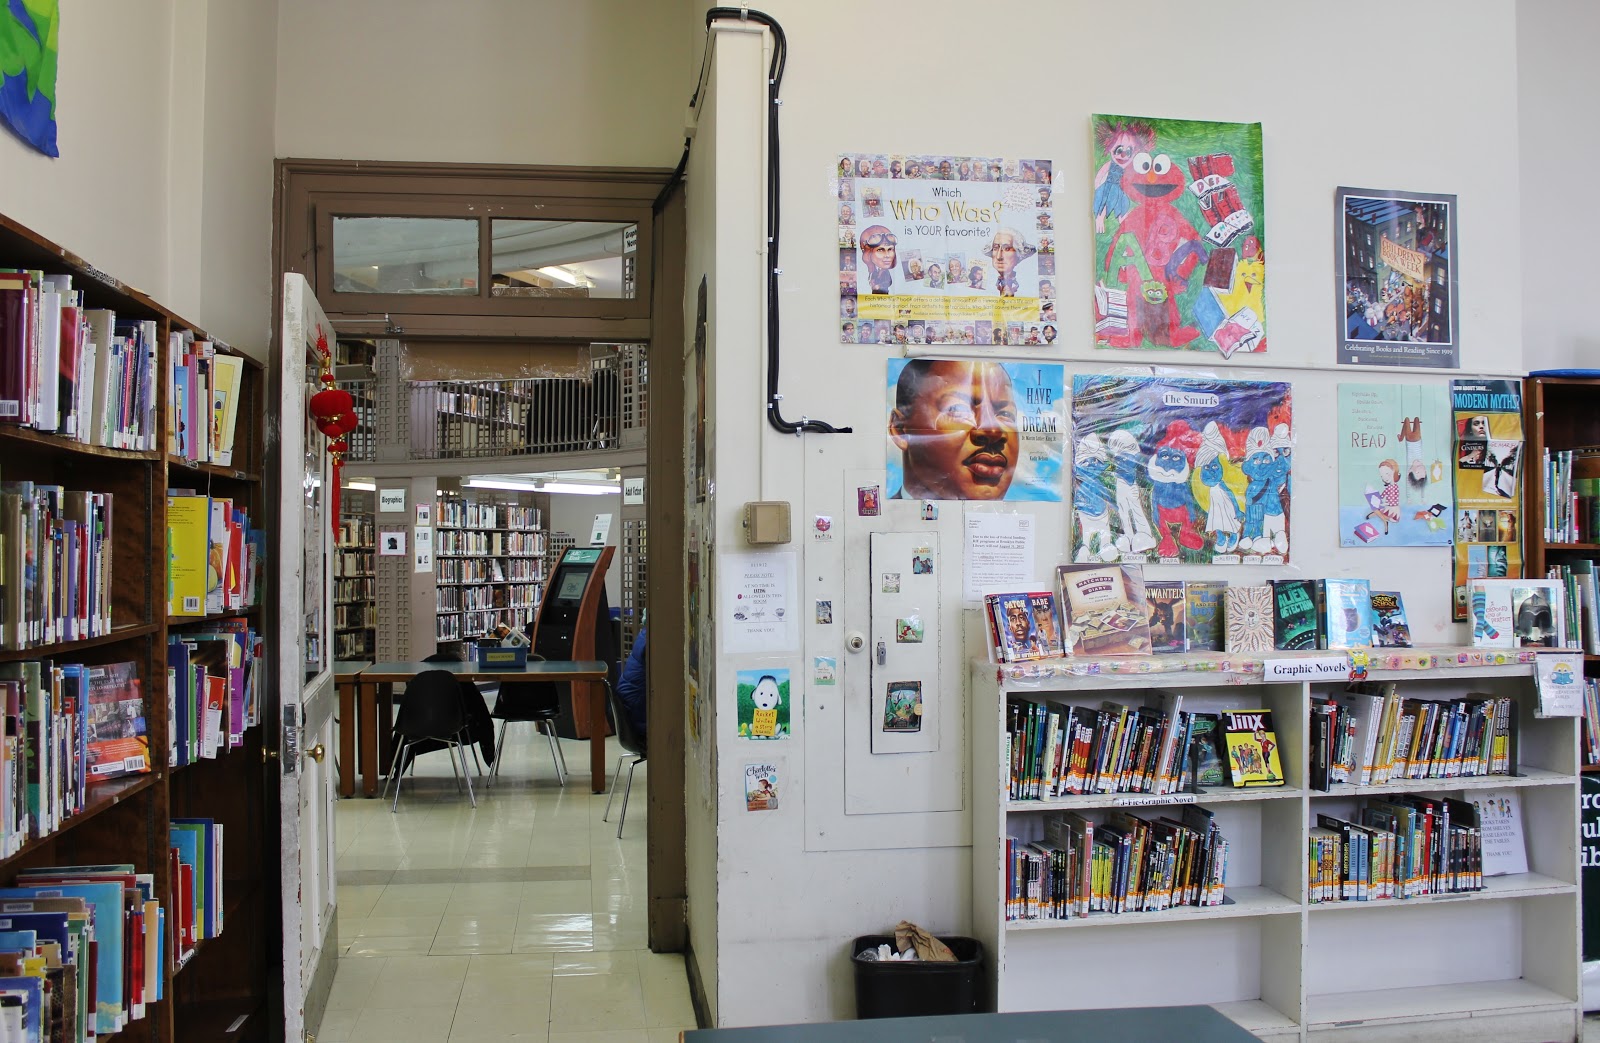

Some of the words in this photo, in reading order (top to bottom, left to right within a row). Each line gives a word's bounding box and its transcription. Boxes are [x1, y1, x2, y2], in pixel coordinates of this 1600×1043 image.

[932, 187, 962, 198] Which
[889, 198, 940, 221] Who
[946, 200, 1003, 223] Was?
[625, 230, 637, 239] Grap
[904, 226, 912, 235] is
[915, 225, 942, 236] YOUR
[945, 225, 991, 237] favorite?
[1344, 343, 1375, 354] Celebrating
[1376, 345, 1392, 353] Books
[1392, 345, 1403, 353] and
[1403, 346, 1426, 355] Reading
[1426, 347, 1440, 355] Since
[1441, 348, 1453, 356] 1919
[1037, 369, 1042, 386] I
[1026, 387, 1052, 404] HAVE
[1164, 394, 1182, 404] The
[1183, 394, 1218, 406] Smurfs
[1454, 393, 1488, 409] MODERN
[1490, 393, 1520, 410] MYTHS?
[1022, 416, 1057, 433] DREAM
[1351, 431, 1387, 449] READ
[1078, 577, 1112, 587] MATCHBOX
[1145, 587, 1184, 599] NWANTEDS
[1277, 587, 1310, 609] ALIEN
[1003, 599, 1026, 609] SATCH
[1032, 598, 1049, 606] BABE
[1280, 599, 1315, 618] DETECTION
[1273, 662, 1313, 676] Graphic
[1315, 662, 1346, 673] Novels
[1226, 712, 1265, 732] Jinx
[746, 764, 777, 777] Charlotte's
[1120, 797, 1172, 806] J-Fic-Graphic
